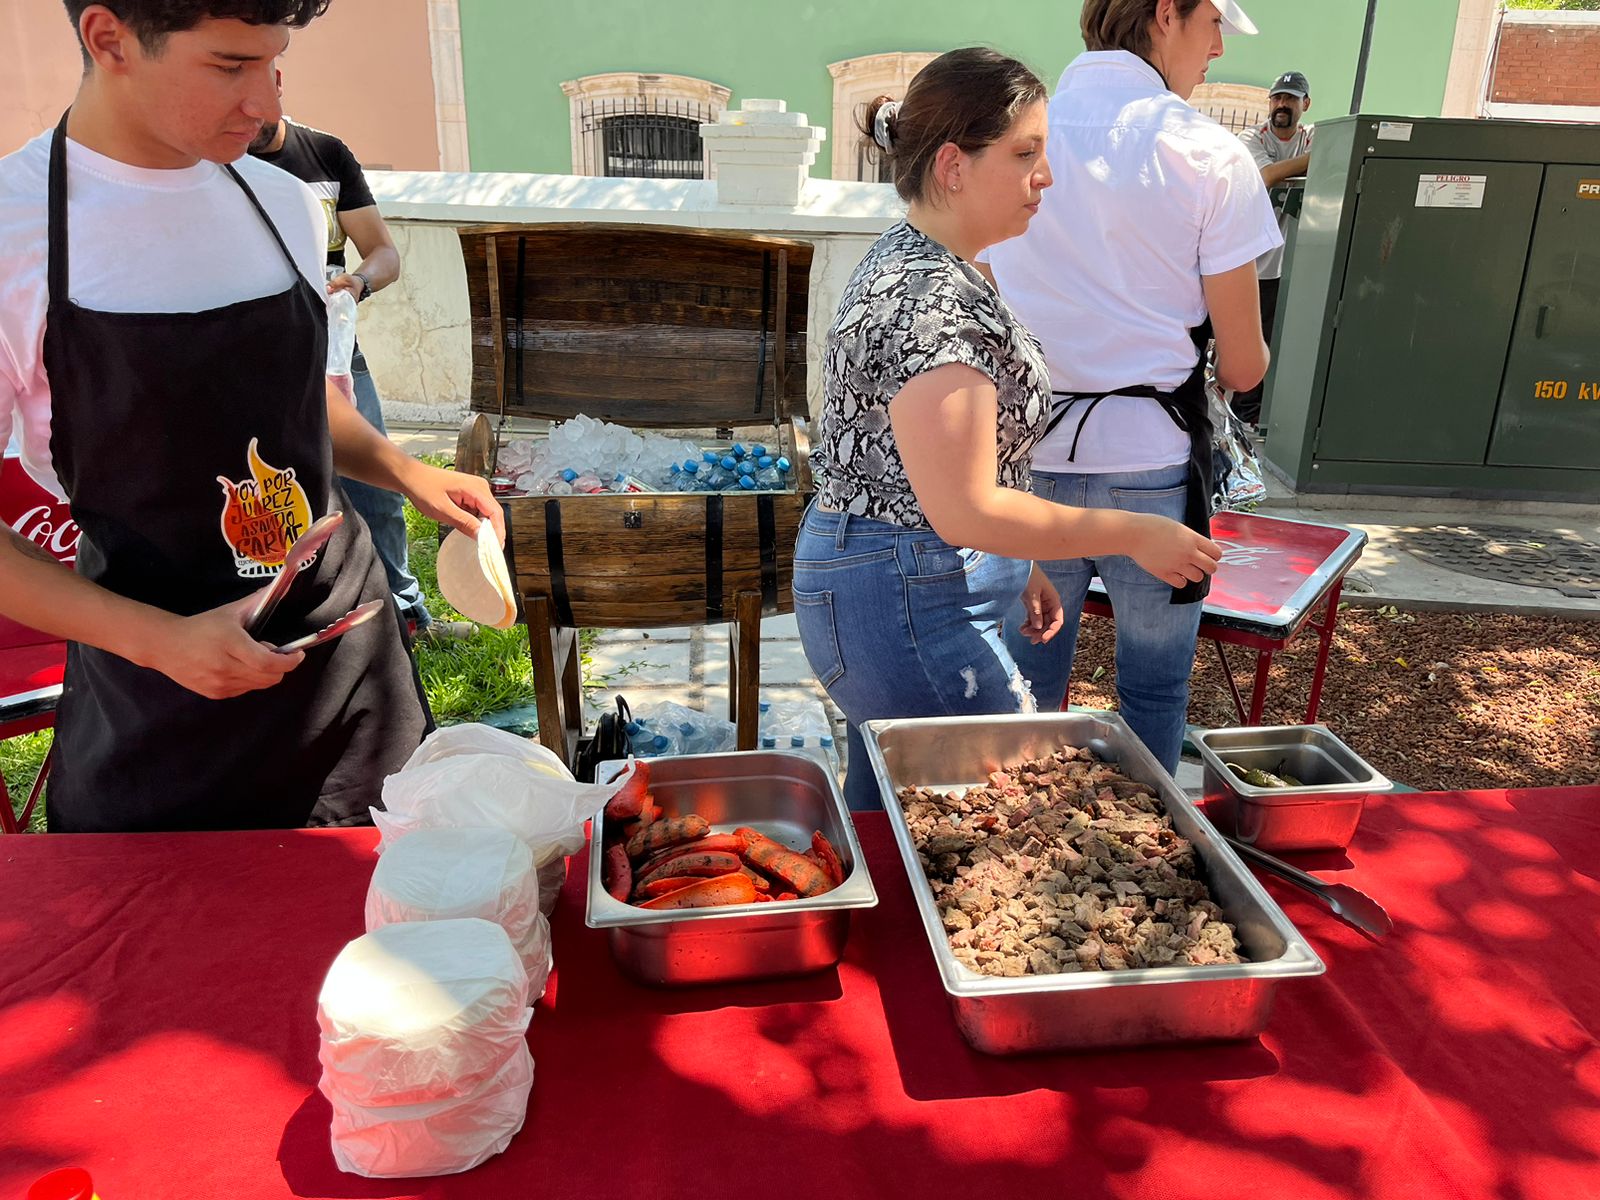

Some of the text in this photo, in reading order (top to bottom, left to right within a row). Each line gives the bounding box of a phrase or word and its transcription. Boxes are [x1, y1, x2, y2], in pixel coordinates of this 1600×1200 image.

[1283, 74, 1292, 83] N
[1435, 175, 1471, 183] PELIGRO
[1534, 380, 1568, 400] 150
[263, 470, 294, 492] POR
[231, 487, 295, 525] JUAREZ
[242, 510, 296, 538] ASANDO
